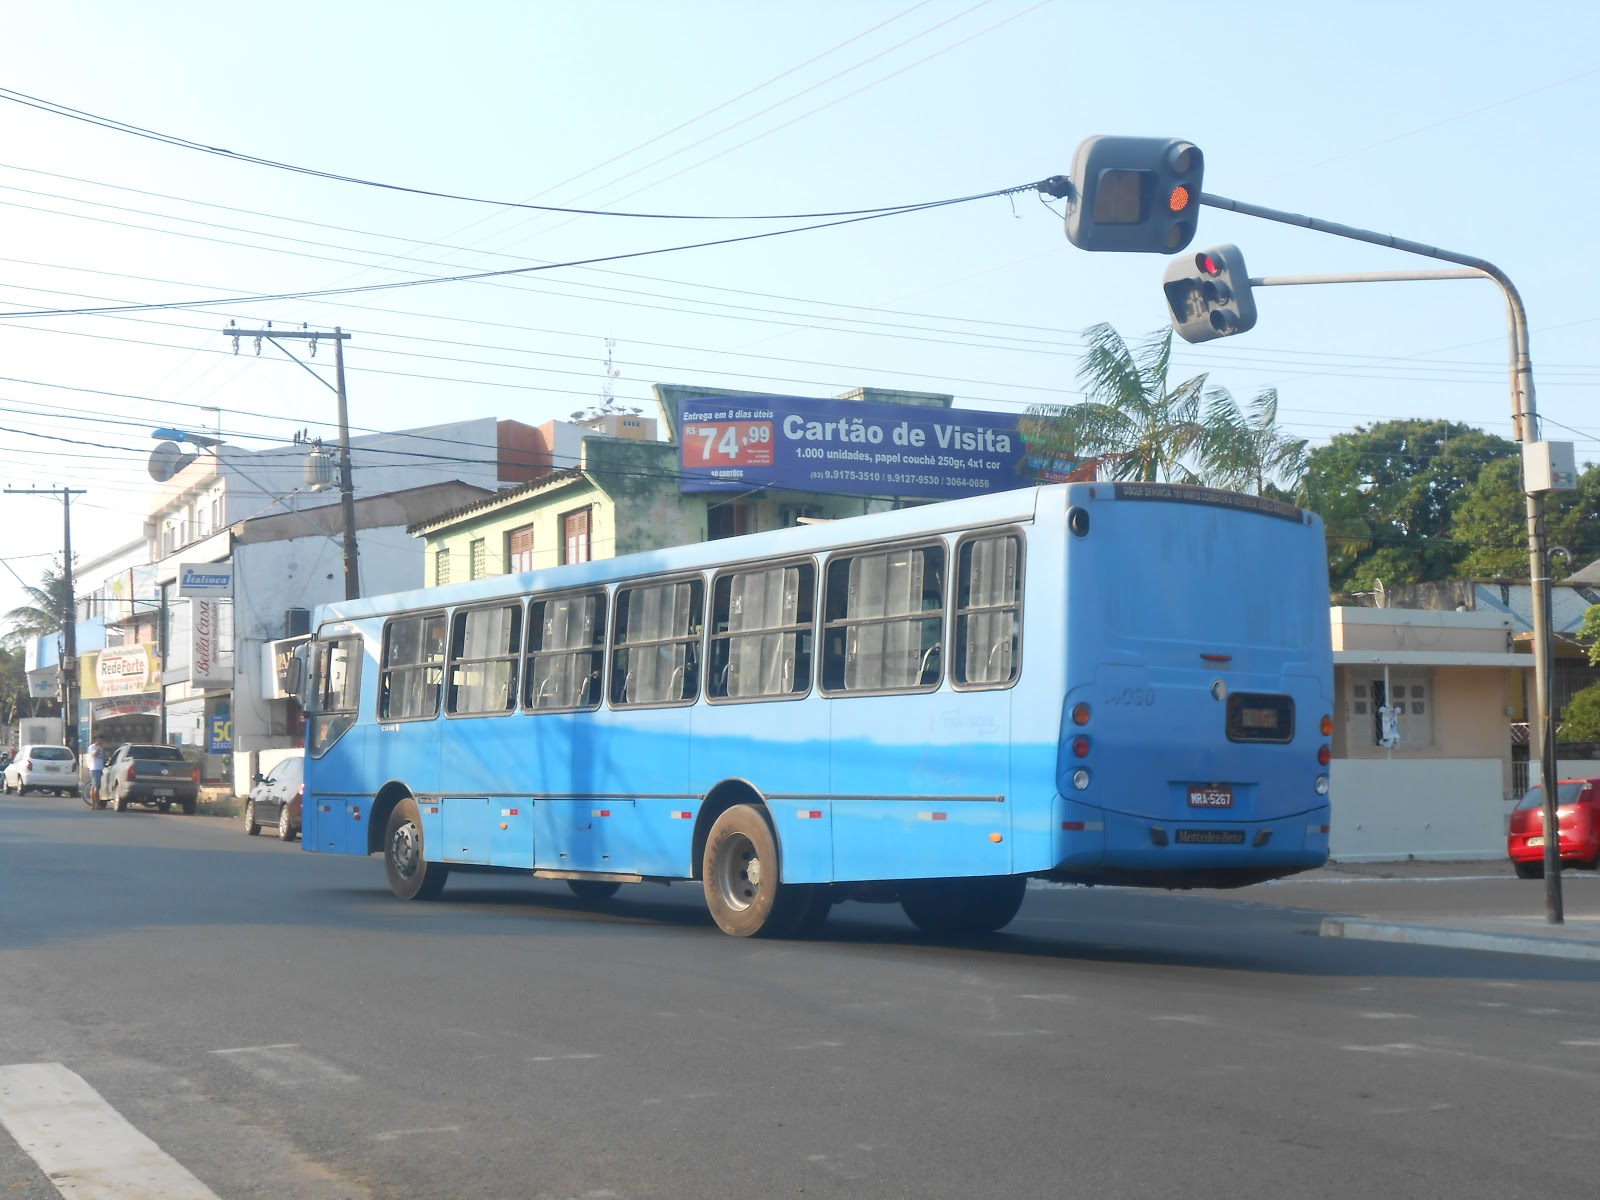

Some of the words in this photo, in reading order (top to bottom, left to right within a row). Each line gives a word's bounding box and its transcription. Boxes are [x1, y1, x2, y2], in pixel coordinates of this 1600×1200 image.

[683, 412, 713, 421] Entrega
[728, 410, 734, 418] 8
[735, 410, 752, 418] dias
[754, 410, 774, 418] úteis
[685, 427, 696, 435] R$
[782, 414, 884, 444] Cartão
[892, 422, 926, 447] de
[933, 424, 1011, 453] Visita
[795, 448, 824, 459] 1.000
[826, 449, 873, 463] unidades,
[875, 452, 901, 464] papel
[937, 456, 966, 469] 250gr,
[967, 458, 983, 468] 4x1
[986, 460, 1001, 470] cor
[824, 470, 880, 481] 9.9175-3510
[886, 474, 940, 485] 9.9127-9530
[946, 476, 990, 488] 3064-0656
[196, 600, 210, 636] Casa
[195, 638, 210, 677] Bella
[213, 721, 232, 742] 50
[1178, 831, 1243, 843] Mercedes-Benz
